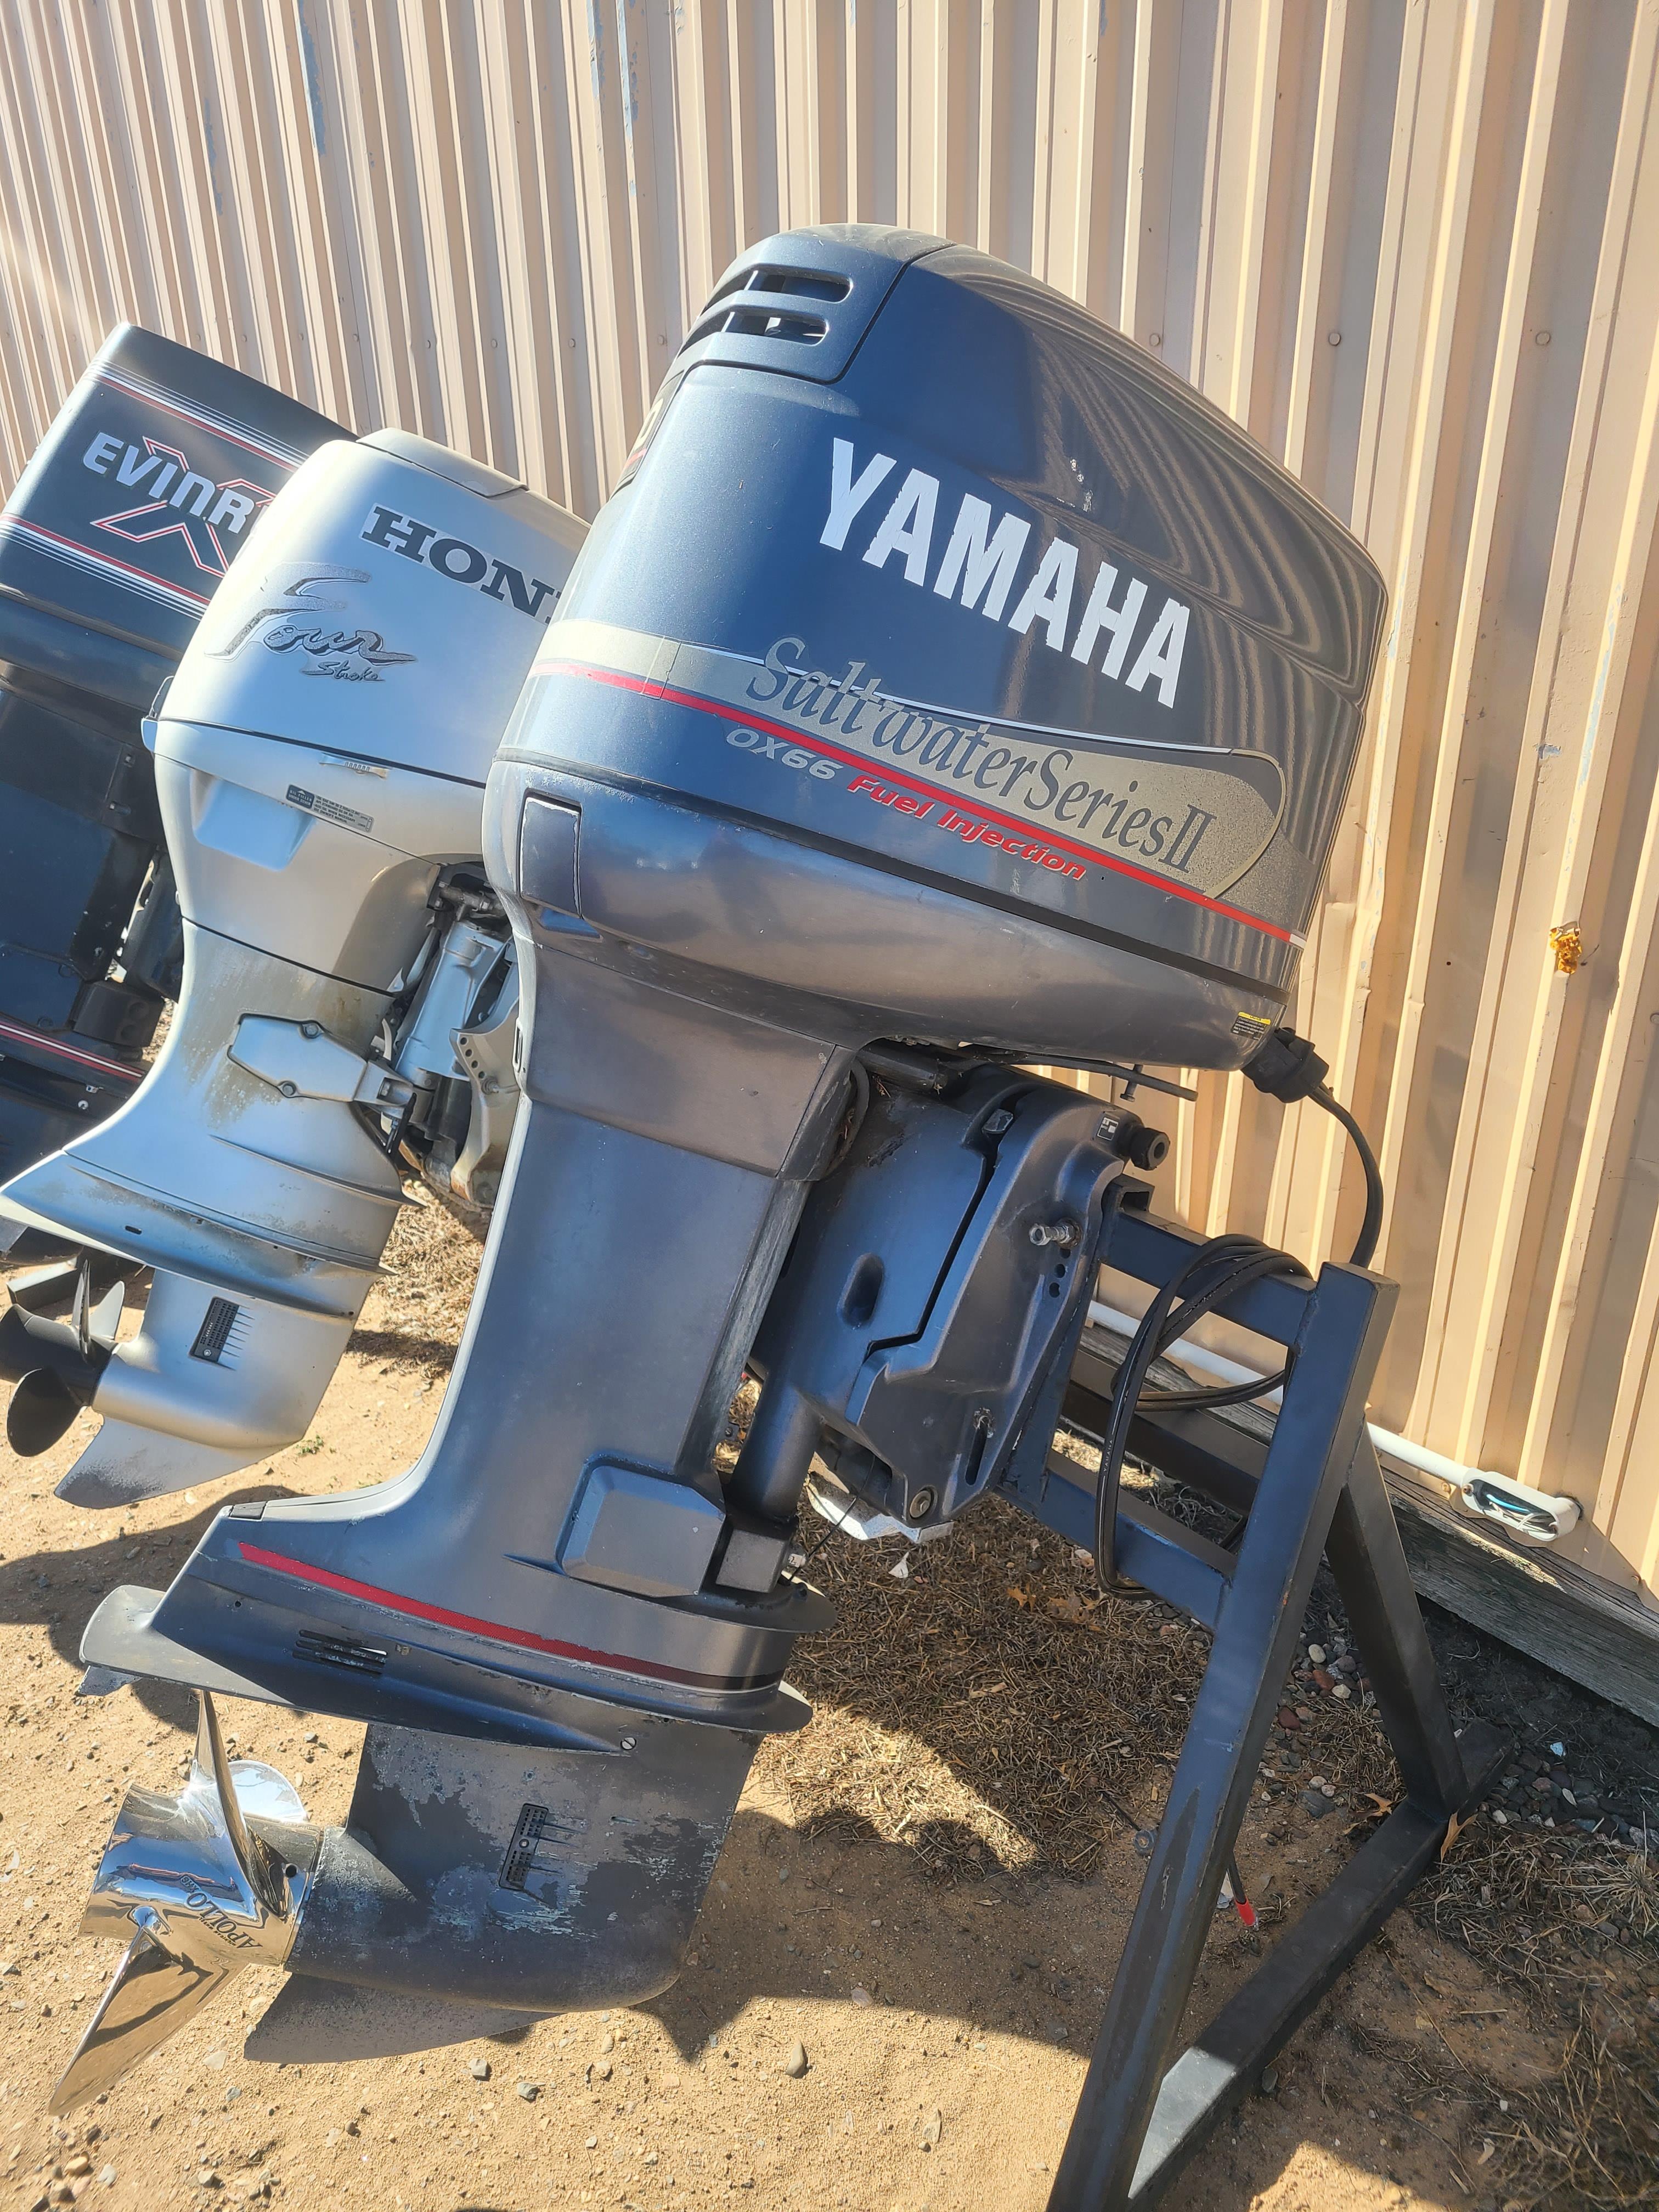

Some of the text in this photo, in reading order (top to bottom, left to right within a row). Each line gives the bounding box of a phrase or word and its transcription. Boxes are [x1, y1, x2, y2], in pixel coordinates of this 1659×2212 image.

[82, 431, 269, 535] EVINR
[204, 562, 417, 666] Four
[362, 506, 562, 624] HON
[820, 437, 1190, 708] YAMAHA
[302, 660, 385, 681] Stroke
[726, 729, 1087, 881] OX66 Fuel Injection
[187, 1892, 263, 1949] APOLLO
